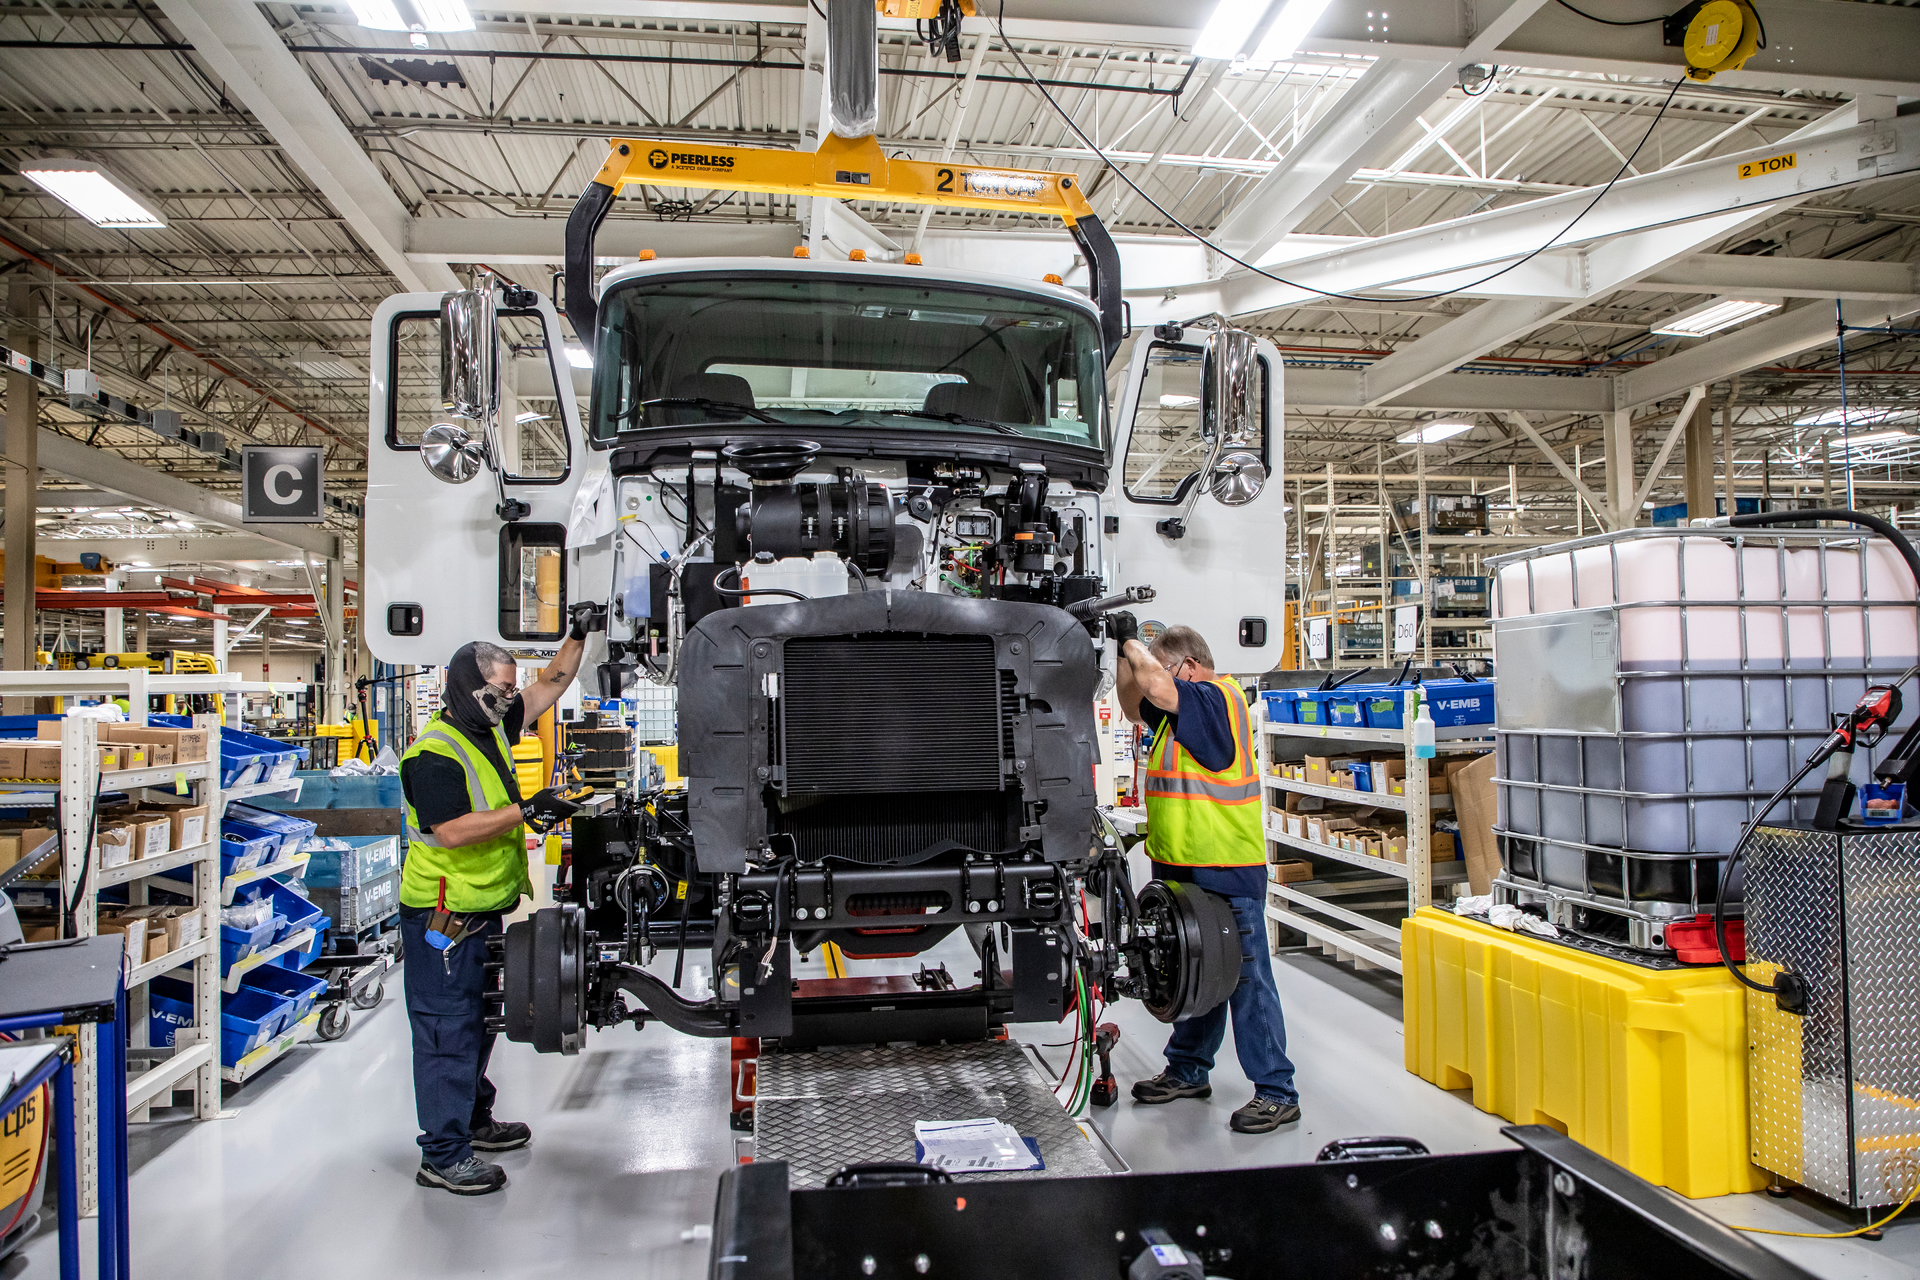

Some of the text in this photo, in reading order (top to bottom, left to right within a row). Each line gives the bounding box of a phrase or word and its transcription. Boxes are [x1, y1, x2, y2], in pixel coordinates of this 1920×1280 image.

[671, 153, 735, 167] PEERLESS
[1743, 155, 1793, 177] 2 TON
[937, 169, 954, 192] 2
[263, 464, 303, 505] C
[1312, 633, 1325, 647] D50
[1398, 623, 1414, 639] D60
[1436, 698, 1480, 710] V-EMB
[364, 880, 392, 904] V-EMB
[151, 1008, 193, 1028] V-EM
